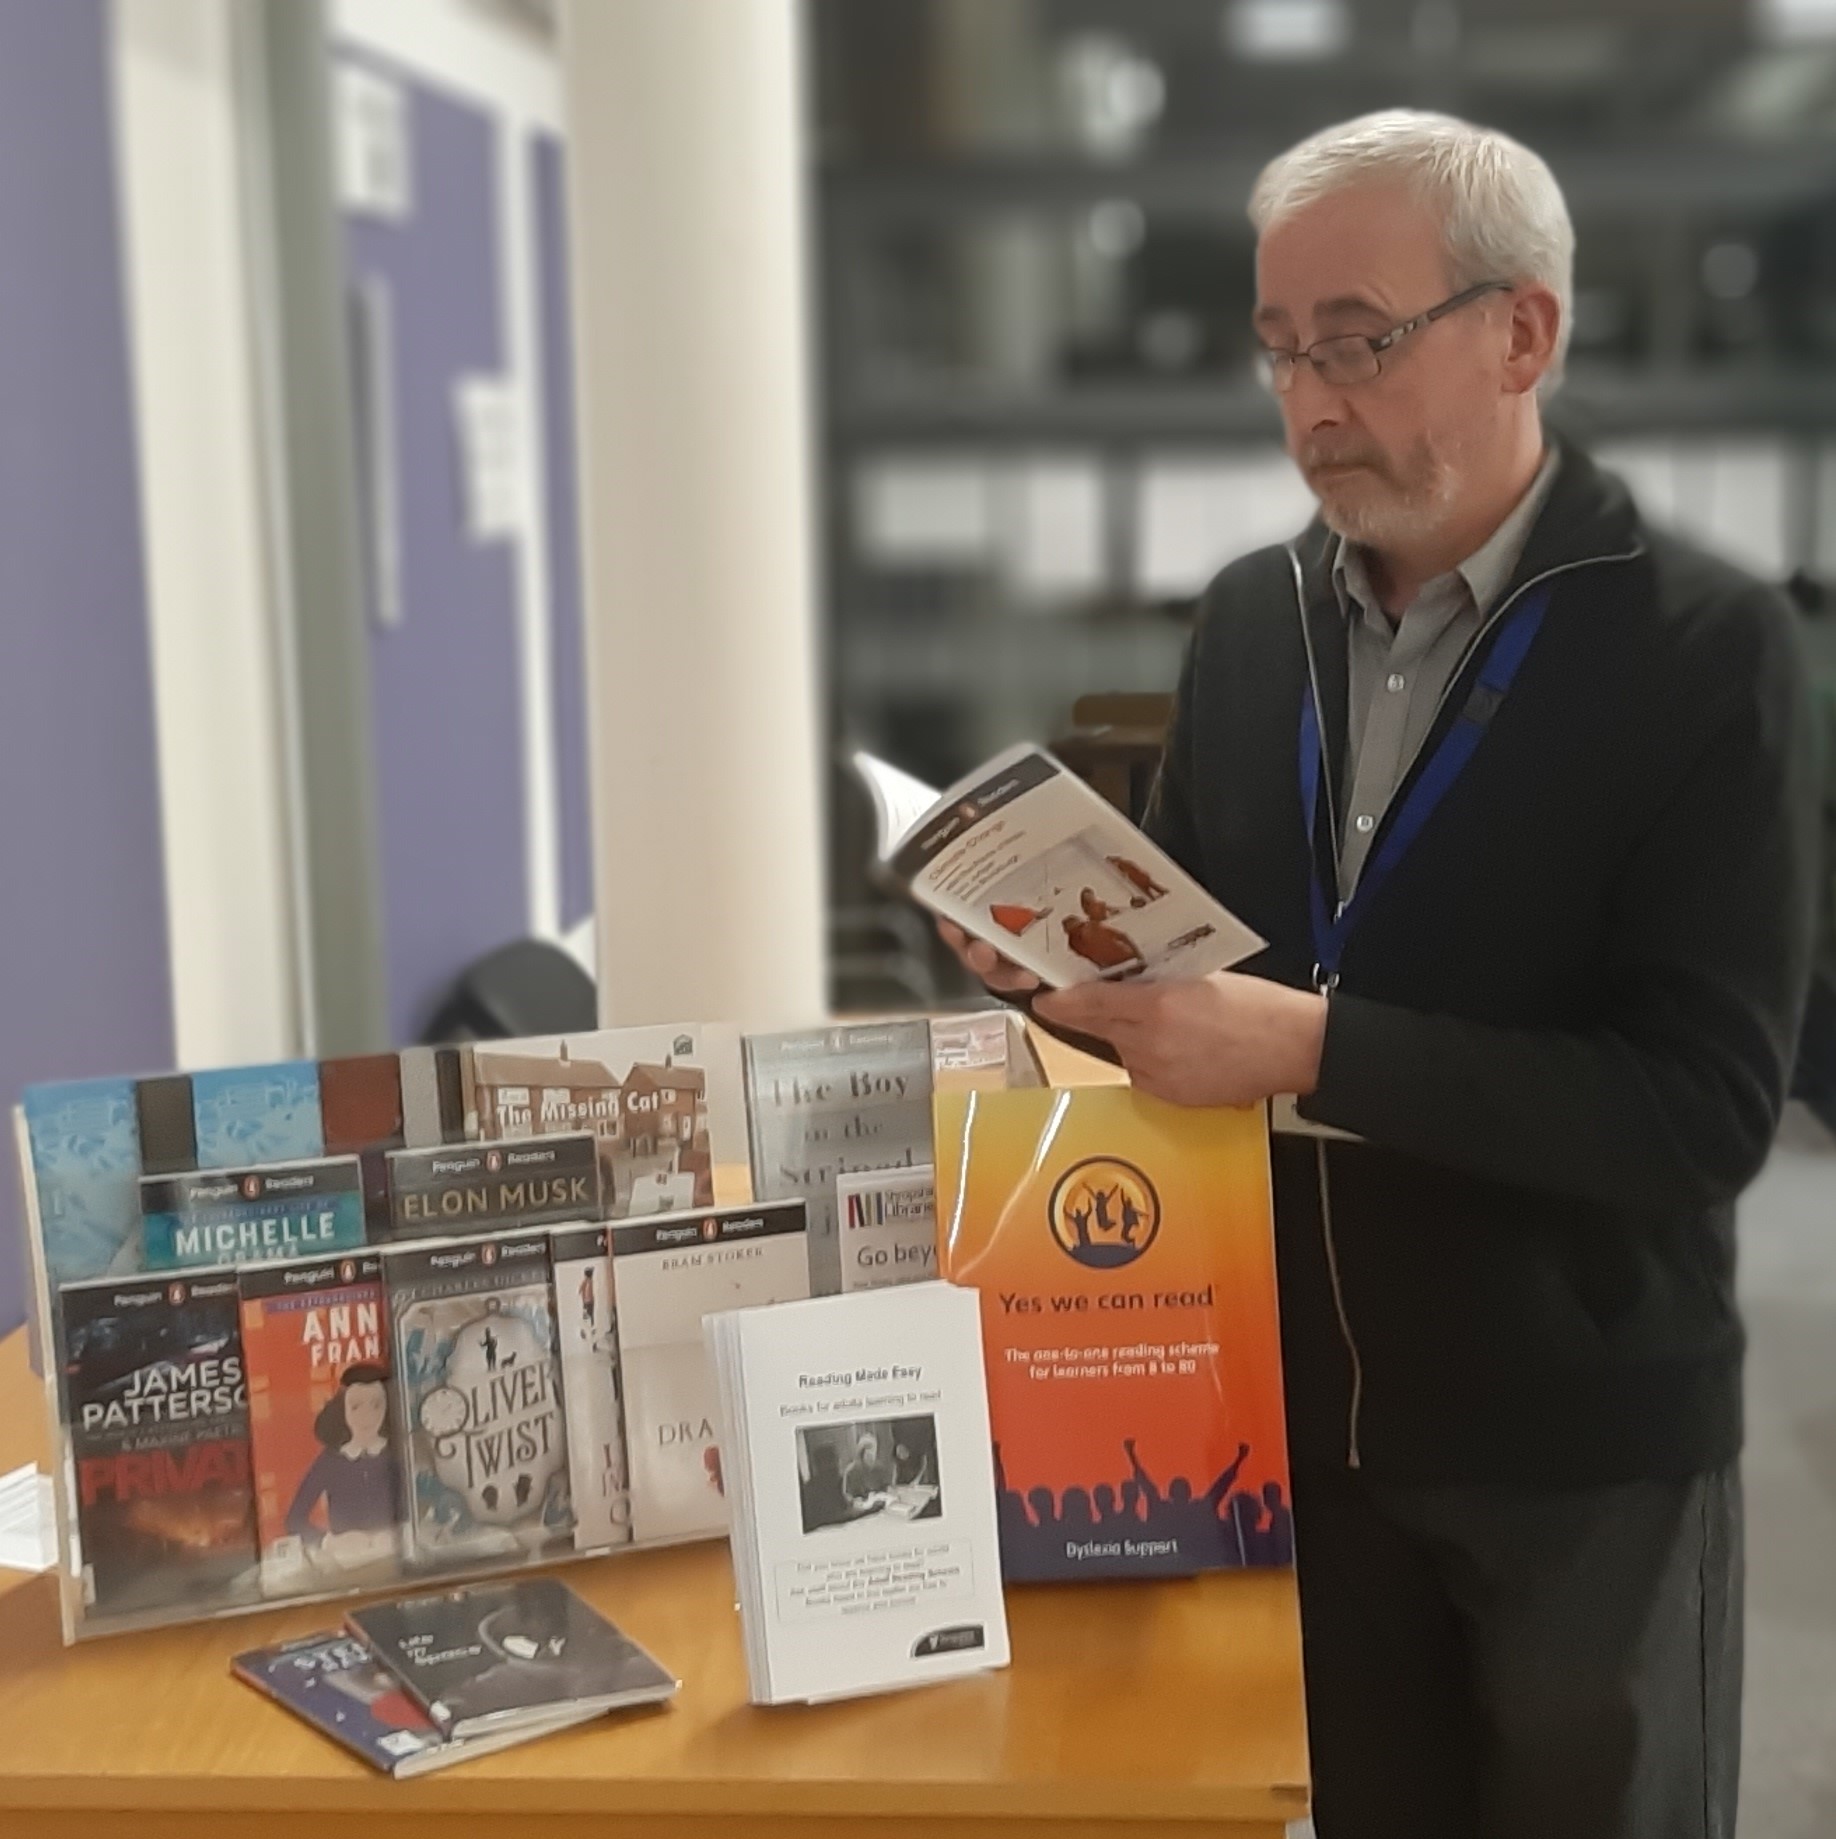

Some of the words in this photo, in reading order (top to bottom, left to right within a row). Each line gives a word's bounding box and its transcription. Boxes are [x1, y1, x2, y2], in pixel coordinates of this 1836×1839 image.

[851, 1072, 908, 1098] Boy
[497, 1105, 531, 1126] The
[541, 1095, 619, 1121] Missing
[627, 1091, 660, 1112] Cat
[404, 1188, 488, 1220] ELON
[500, 1177, 588, 1212] MUSK
[176, 1212, 335, 1256] MICHELLE
[857, 1245, 888, 1267] Go
[1000, 1292, 1042, 1314] Yes
[1051, 1295, 1089, 1312] we
[1098, 1293, 1144, 1310] can
[1154, 1285, 1214, 1309] read
[303, 1301, 379, 1345] ANN
[1005, 1347, 1030, 1362] The
[1113, 1343, 1165, 1360] reading
[123, 1356, 243, 1398] JAMES
[799, 1372, 852, 1388] Reading
[856, 1367, 889, 1382] Made
[892, 1365, 922, 1382] Easy
[1030, 1364, 1048, 1379] for
[1053, 1362, 1109, 1378] learners
[1113, 1360, 1145, 1376] from
[1161, 1360, 1175, 1374] to
[464, 1410, 555, 1489] TWIST
[1066, 1540, 1120, 1560] Dyslexia
[1124, 1539, 1178, 1559] Support
